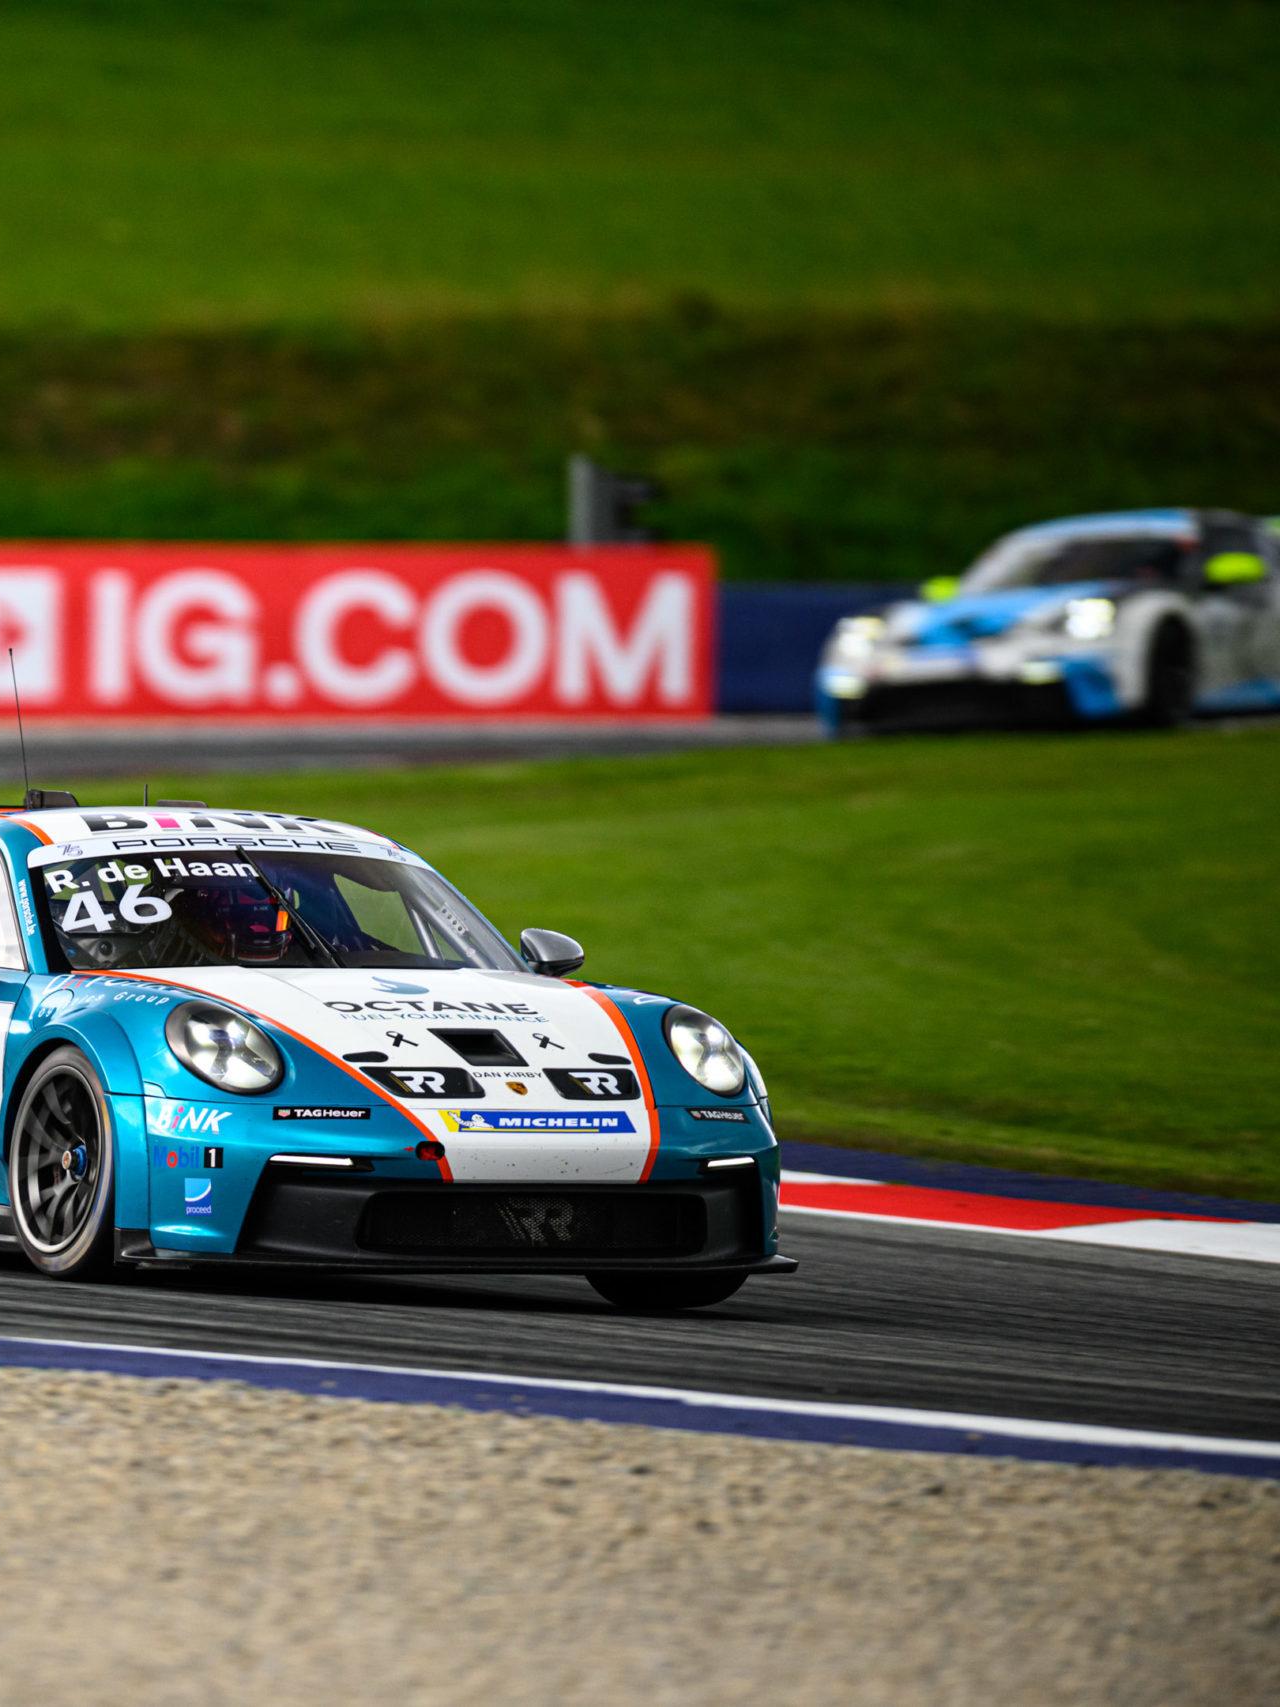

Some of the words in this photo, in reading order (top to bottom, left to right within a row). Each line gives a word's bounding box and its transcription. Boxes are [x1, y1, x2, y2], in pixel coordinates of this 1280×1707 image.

[88, 567, 695, 707] IG.COM
[112, 837, 361, 854] PORSCHE
[43, 869, 90, 893] R.
[97, 861, 149, 883] de
[153, 858, 259, 878] Haan
[61, 884, 172, 932] 46
[113, 991, 170, 1006] Group
[323, 1000, 539, 1015] OCTANE
[399, 1012, 453, 1020] YOUR
[472, 1071, 502, 1079] DAN
[503, 1071, 542, 1079] KIRBY
[499, 1117, 619, 1128] MICHELIN
[153, 1146, 200, 1168] Mobil
[208, 1148, 217, 1168] 1
[185, 1204, 212, 1215] proceed
